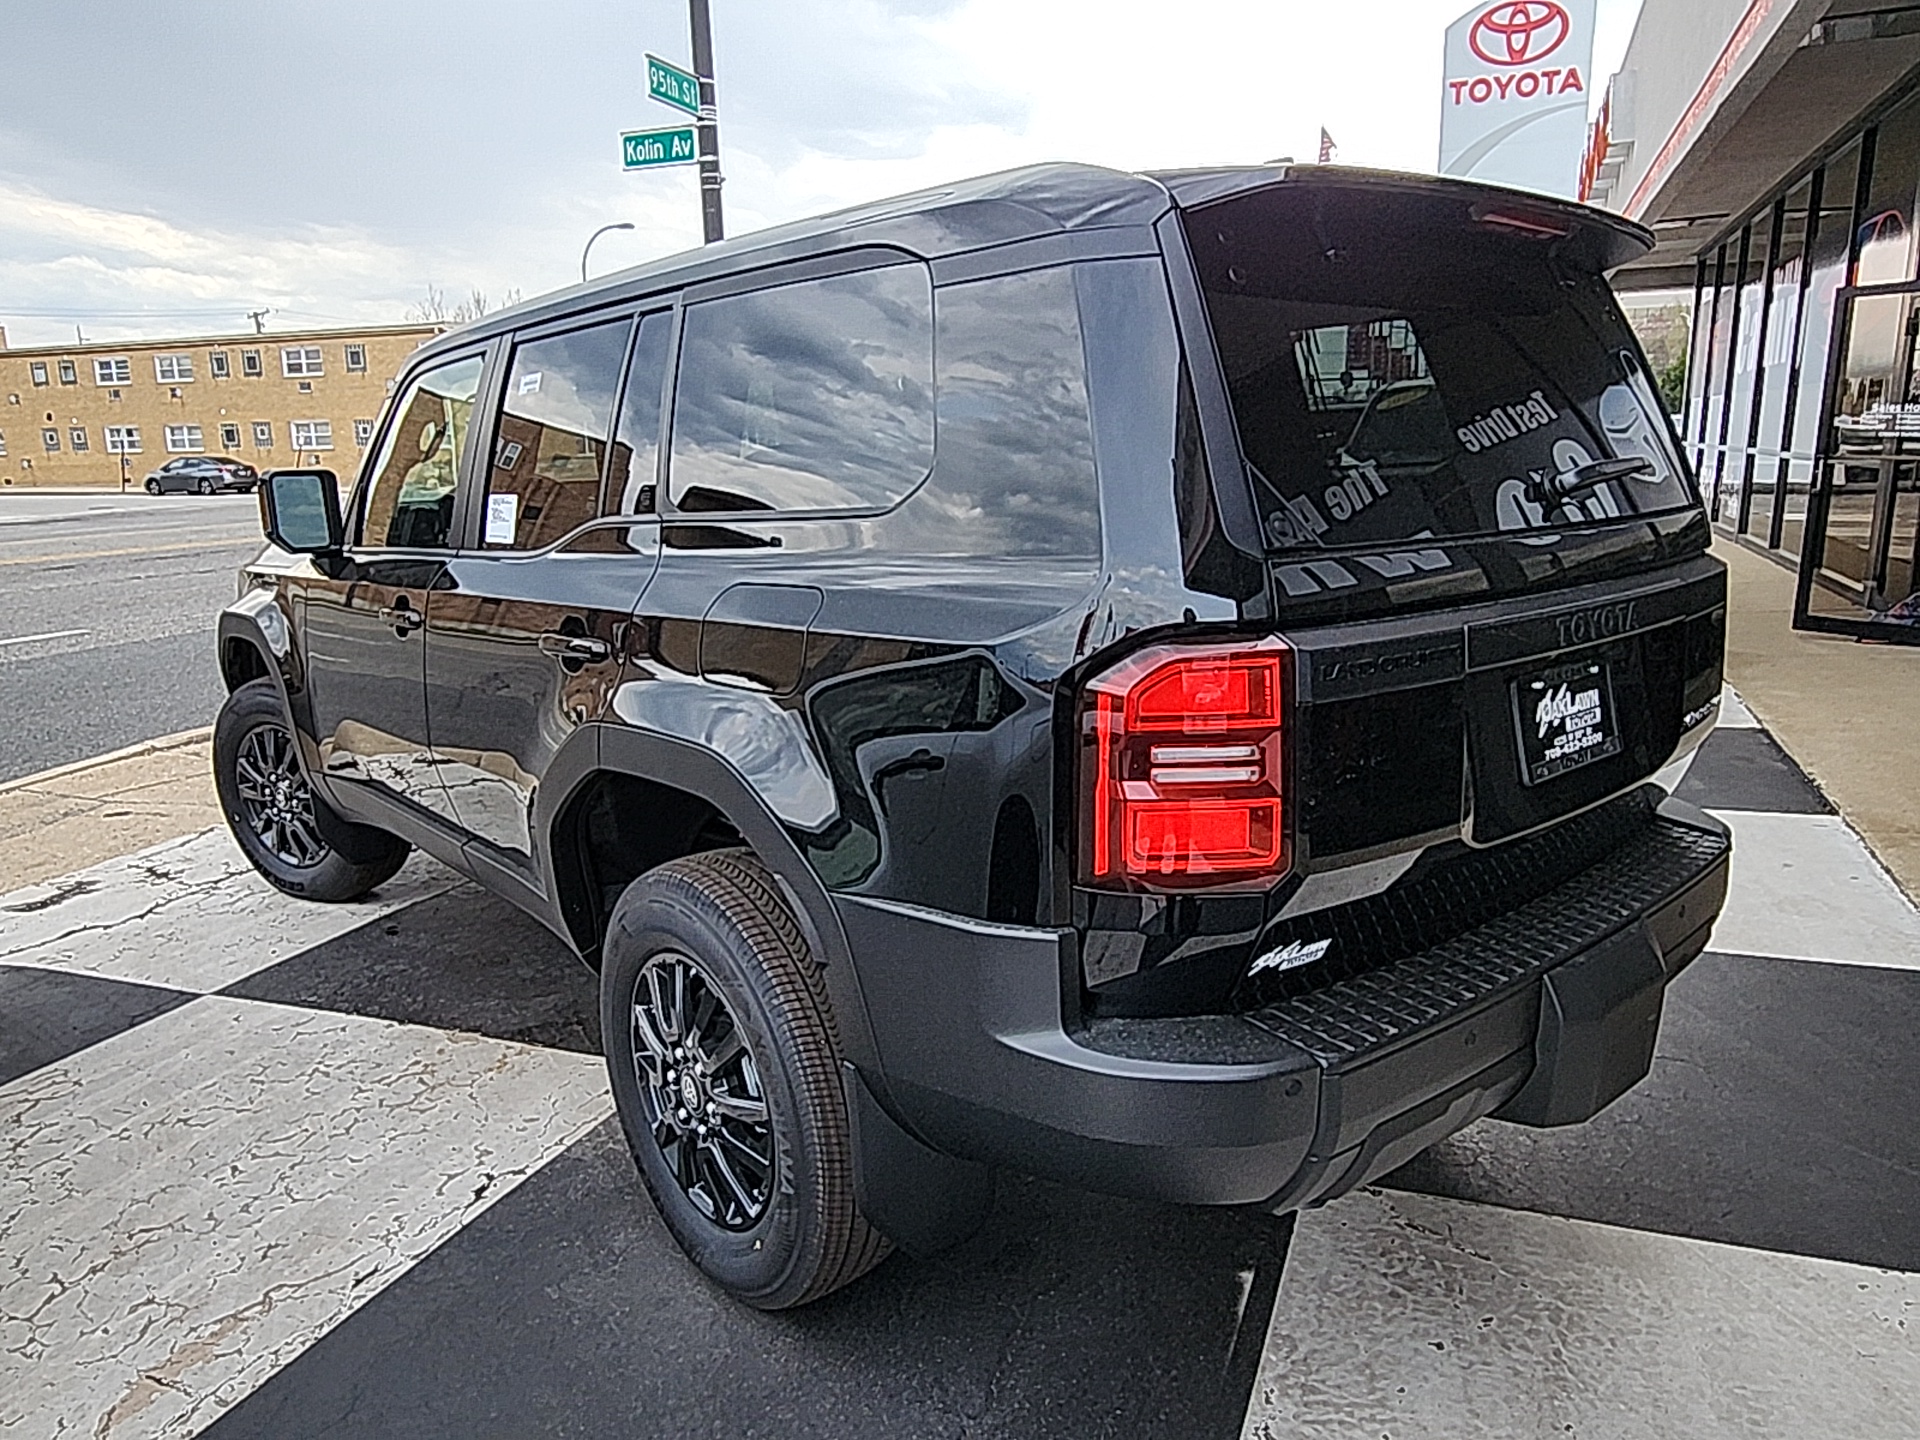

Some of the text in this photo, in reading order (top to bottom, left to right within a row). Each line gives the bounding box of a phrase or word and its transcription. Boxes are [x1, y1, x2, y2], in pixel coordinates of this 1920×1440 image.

[650, 66, 697, 107] 95th St
[1449, 67, 1584, 106] TOYOTA
[625, 135, 692, 163] Kolin Av
[1871, 402, 1902, 413] Sales
[1556, 601, 1640, 648] TOYOTA
